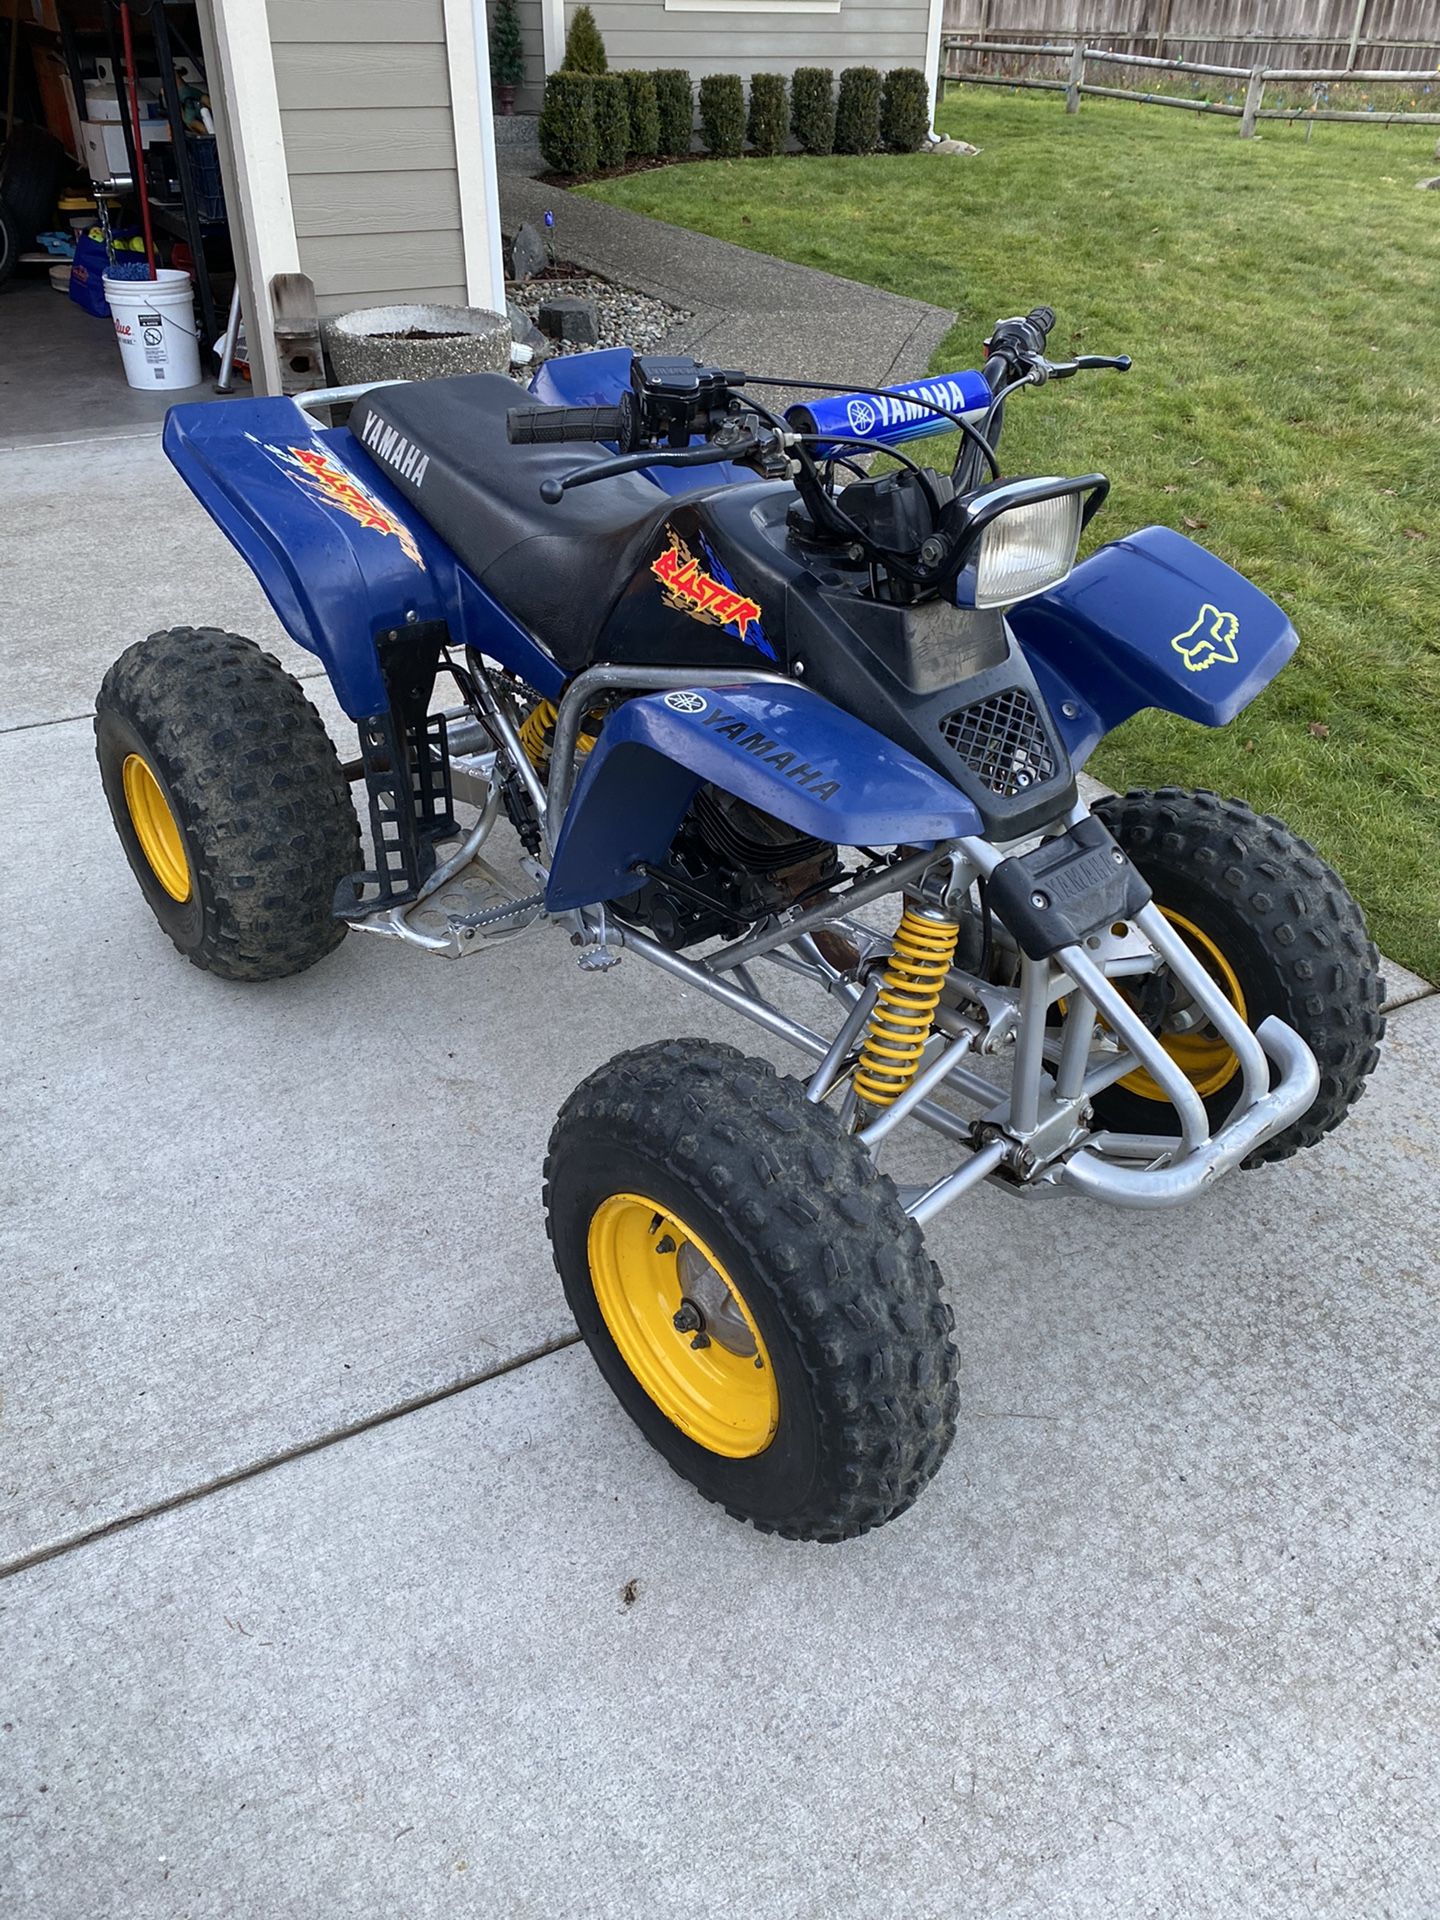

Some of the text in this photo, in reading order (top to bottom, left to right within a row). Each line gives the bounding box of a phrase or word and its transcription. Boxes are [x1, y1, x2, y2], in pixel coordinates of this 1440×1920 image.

[870, 381, 965, 427] YAMAHA
[361, 410, 430, 487] YAMAHA
[290, 446, 394, 536] BLASTER
[650, 547, 762, 641] BLASTER
[702, 708, 841, 802] YAMAHA
[1044, 852, 1119, 901] YAMAHA
